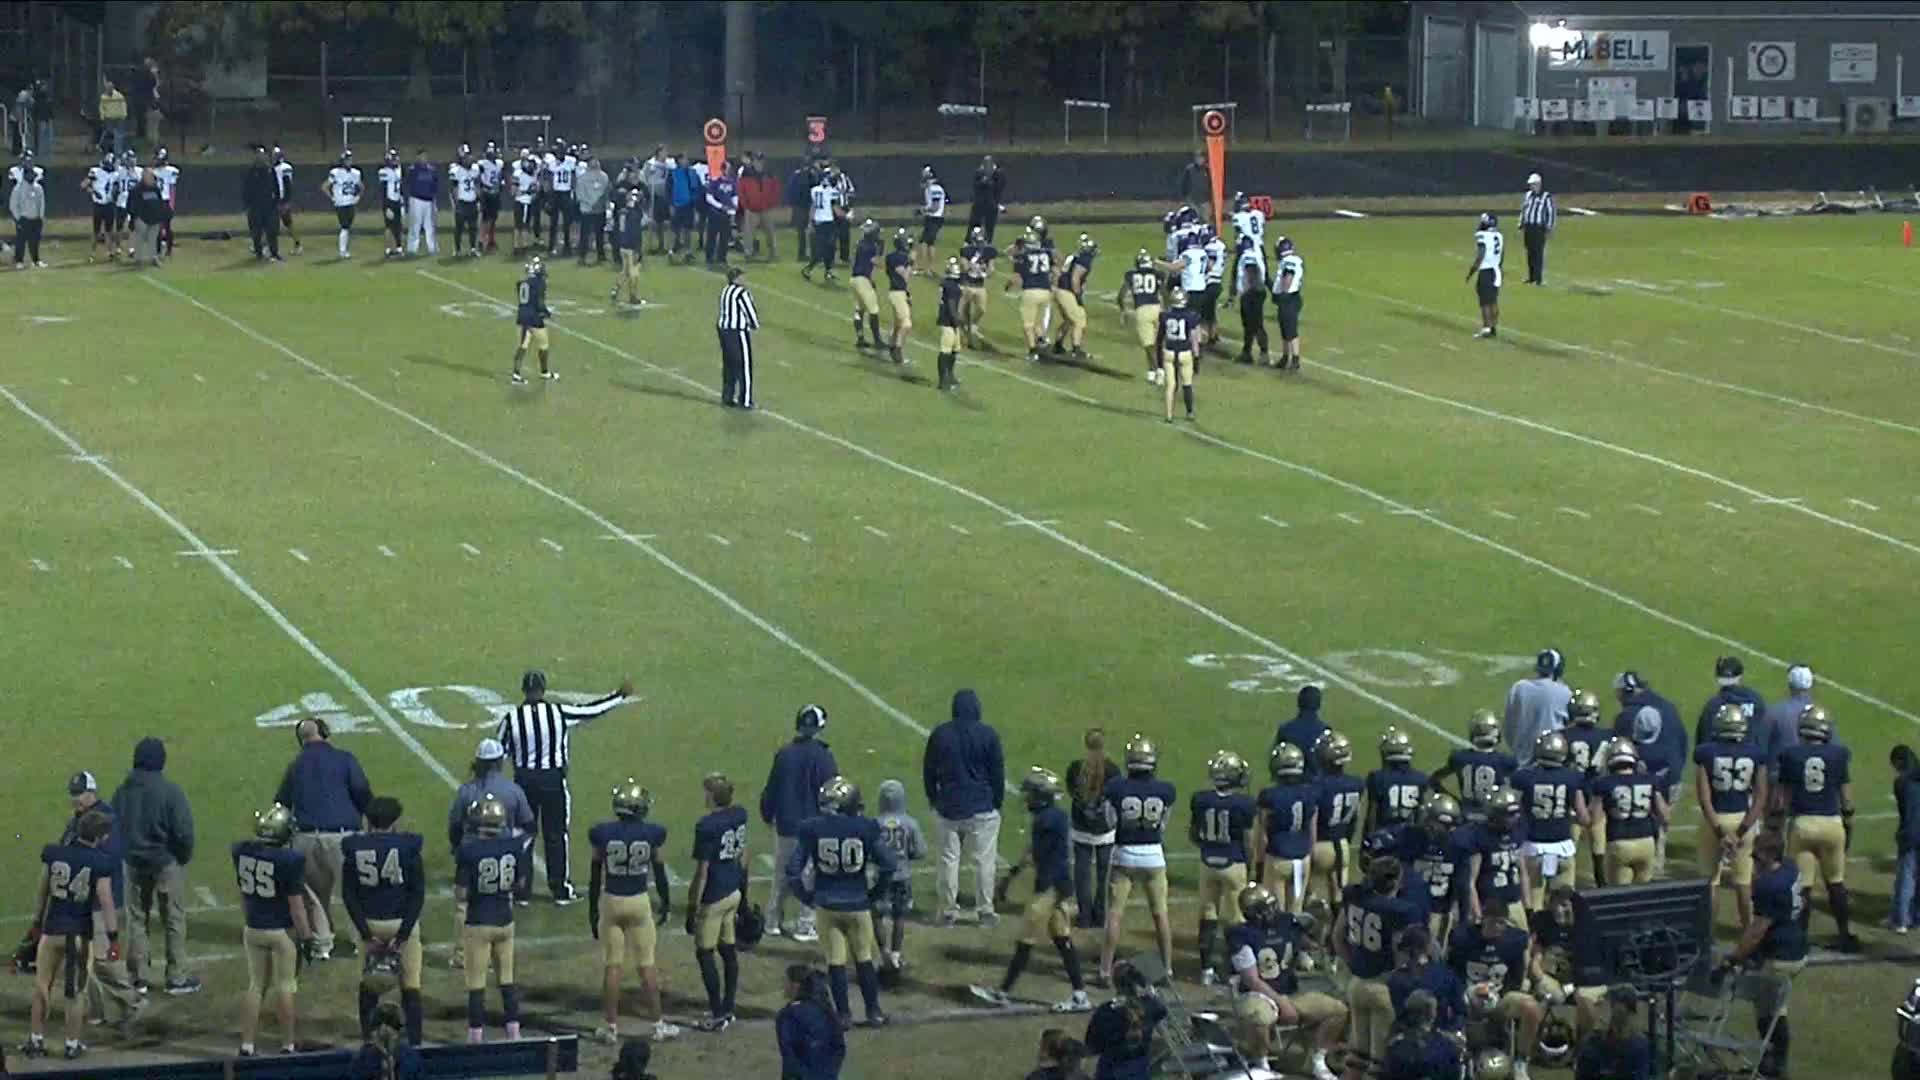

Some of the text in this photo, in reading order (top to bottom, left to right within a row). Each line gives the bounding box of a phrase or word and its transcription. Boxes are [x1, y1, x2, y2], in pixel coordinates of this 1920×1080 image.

[808, 121, 825, 142] 3
[1132, 273, 1157, 294] 20
[1165, 317, 1187, 341] 21
[1711, 756, 1755, 793] 53
[1388, 784, 1420, 819] 15
[1532, 783, 1568, 819] 51
[1205, 807, 1232, 844] 11
[355, 848, 404, 887] 54
[605, 839, 652, 877] 22
[817, 837, 865, 874] 50
[48, 860, 92, 902] 24
[238, 854, 277, 899] 55
[1345, 904, 1383, 952] 56
